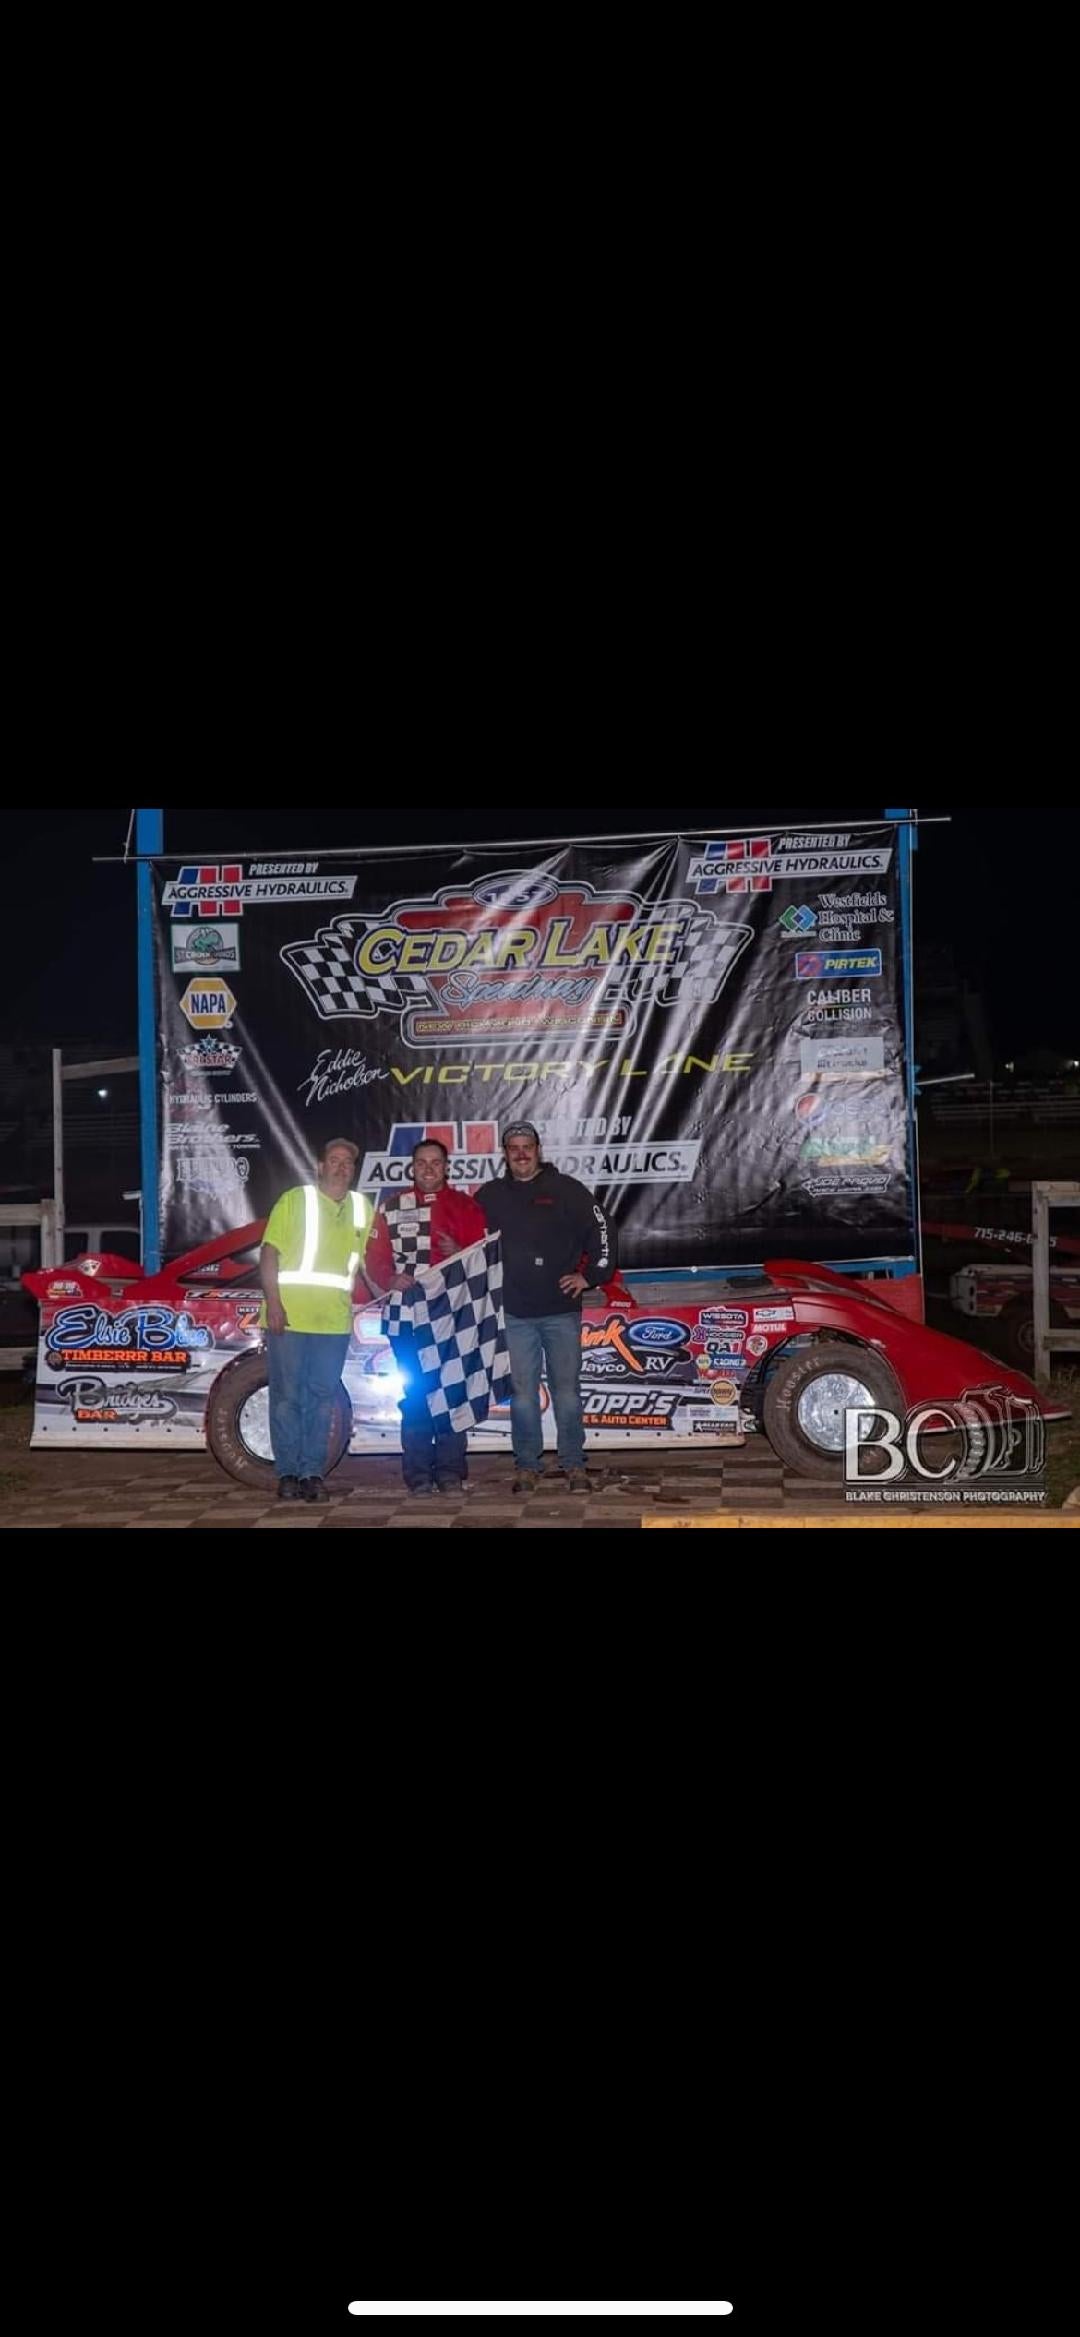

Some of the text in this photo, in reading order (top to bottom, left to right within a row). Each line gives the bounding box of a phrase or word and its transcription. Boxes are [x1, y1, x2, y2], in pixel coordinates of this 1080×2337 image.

[778, 834, 850, 850] PRESENTED BY
[249, 862, 319, 876] PRESENTED BY
[692, 859, 782, 876] AGGRESSIVE
[168, 884, 252, 899] AGGRESSIVE
[818, 891, 887, 908] Westfields
[818, 908, 894, 929] Hospital &
[818, 927, 861, 942] Clinic
[356, 919, 684, 977] CEDAR LAKE
[824, 956, 877, 970] PIRTEK
[440, 970, 598, 1007] Speedway
[807, 988, 871, 1005] CALIBER
[191, 993, 226, 1014] NAPA
[808, 1007, 873, 1022] COLLISION
[315, 1048, 367, 1074] Eddie
[389, 1052, 754, 1086] VICTORY LANE
[297, 1066, 390, 1107] Nicholson
[367, 1157, 507, 1182] AGGSSIV
[702, 1312, 744, 1320] WISSOTA
[47, 1304, 212, 1350] Elsie Blue
[641, 1326, 672, 1340] Ford
[752, 1323, 787, 1332] MOTUL
[63, 1350, 187, 1363] TIMBERRR BAR
[644, 1356, 674, 1371] RV
[58, 1376, 177, 1419] Bridges
[580, 1391, 677, 1415] OPP'S
[76, 1409, 117, 1420] BAR
[601, 1415, 627, 1425] AUTO
[629, 1415, 667, 1426] CENTER
